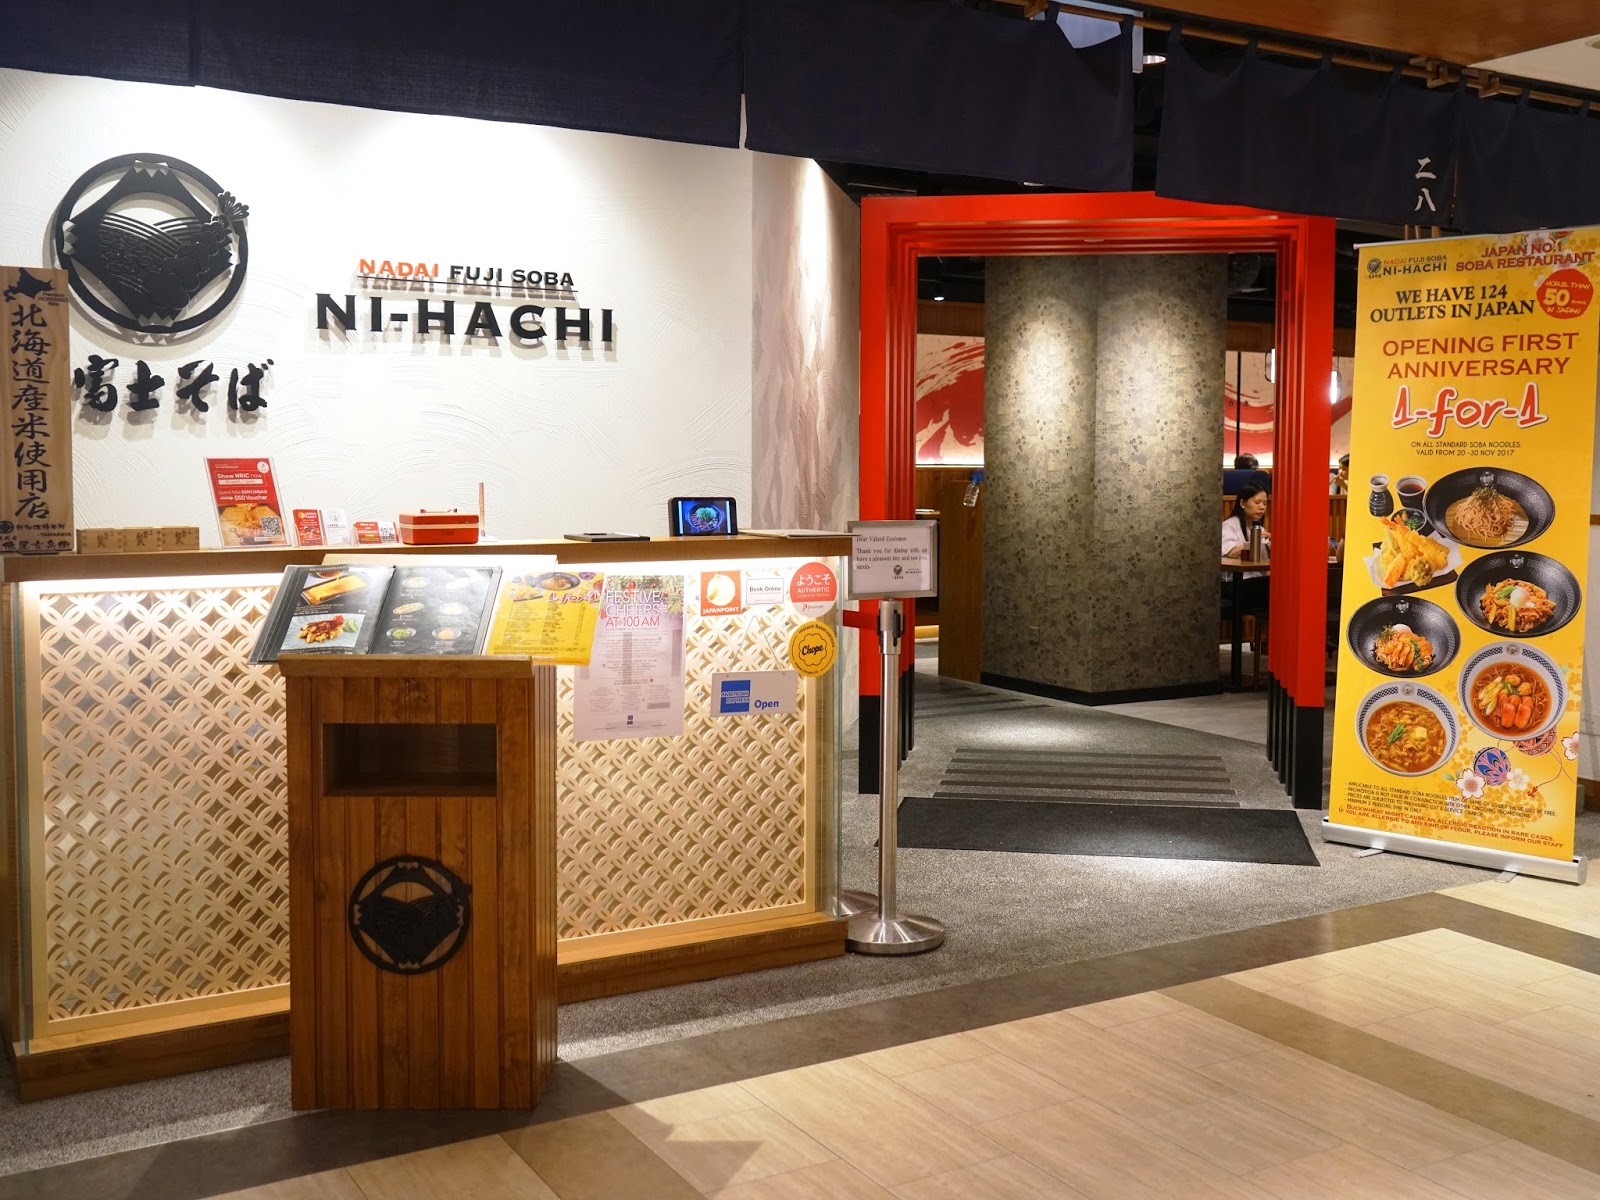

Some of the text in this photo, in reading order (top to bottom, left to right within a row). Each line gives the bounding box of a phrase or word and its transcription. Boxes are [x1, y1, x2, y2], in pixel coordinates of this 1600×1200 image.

[1481, 242, 1563, 258] JAPAN NO.1
[1383, 262, 1447, 276] NI-HACHI
[1456, 251, 1595, 272] SOBA RESTAURANT
[360, 259, 574, 287] NADAI FUJI SOBA
[1545, 280, 1591, 290] MORE THAN
[1396, 284, 1508, 304] WE HAVE 124
[1543, 289, 1571, 307] 50
[316, 293, 613, 342] NI-HACHI
[1370, 300, 1536, 322] OUTLETS IN JAPAN
[1556, 307, 1581, 315] JAPAN
[1383, 332, 1579, 356] OPENING FIRST
[1387, 357, 1571, 379] ANNIVERSARY
[74, 355, 275, 412] 富士そば
[1392, 382, 1548, 439] 1-for-1
[797, 573, 831, 587] ようこそ
[606, 590, 660, 603] FESTIVE
[606, 604, 660, 616] CHEERS
[702, 606, 740, 615] JAPANPOINT
[606, 617, 660, 627] AT 100 AM
[798, 625, 815, 633] Instant
[802, 645, 824, 655] Chope
[754, 700, 779, 710] Open
[1348, 781, 1373, 789] APPLICABLE
[1348, 787, 1374, 795] PROMOTION
[1346, 804, 1383, 814] BUCKWHEAT
[1385, 810, 1404, 818] MIGHT
[1405, 813, 1425, 821] CAUSE
[1436, 818, 1468, 828] ALLERGIC
[1469, 823, 1501, 833] REACTION
[1531, 833, 1555, 841] CASES.
[1371, 813, 1400, 822] ALLERGIC
[1474, 829, 1499, 839] PLEASE
[1501, 834, 1526, 843] INFORM
[1543, 840, 1565, 848] STAFF
